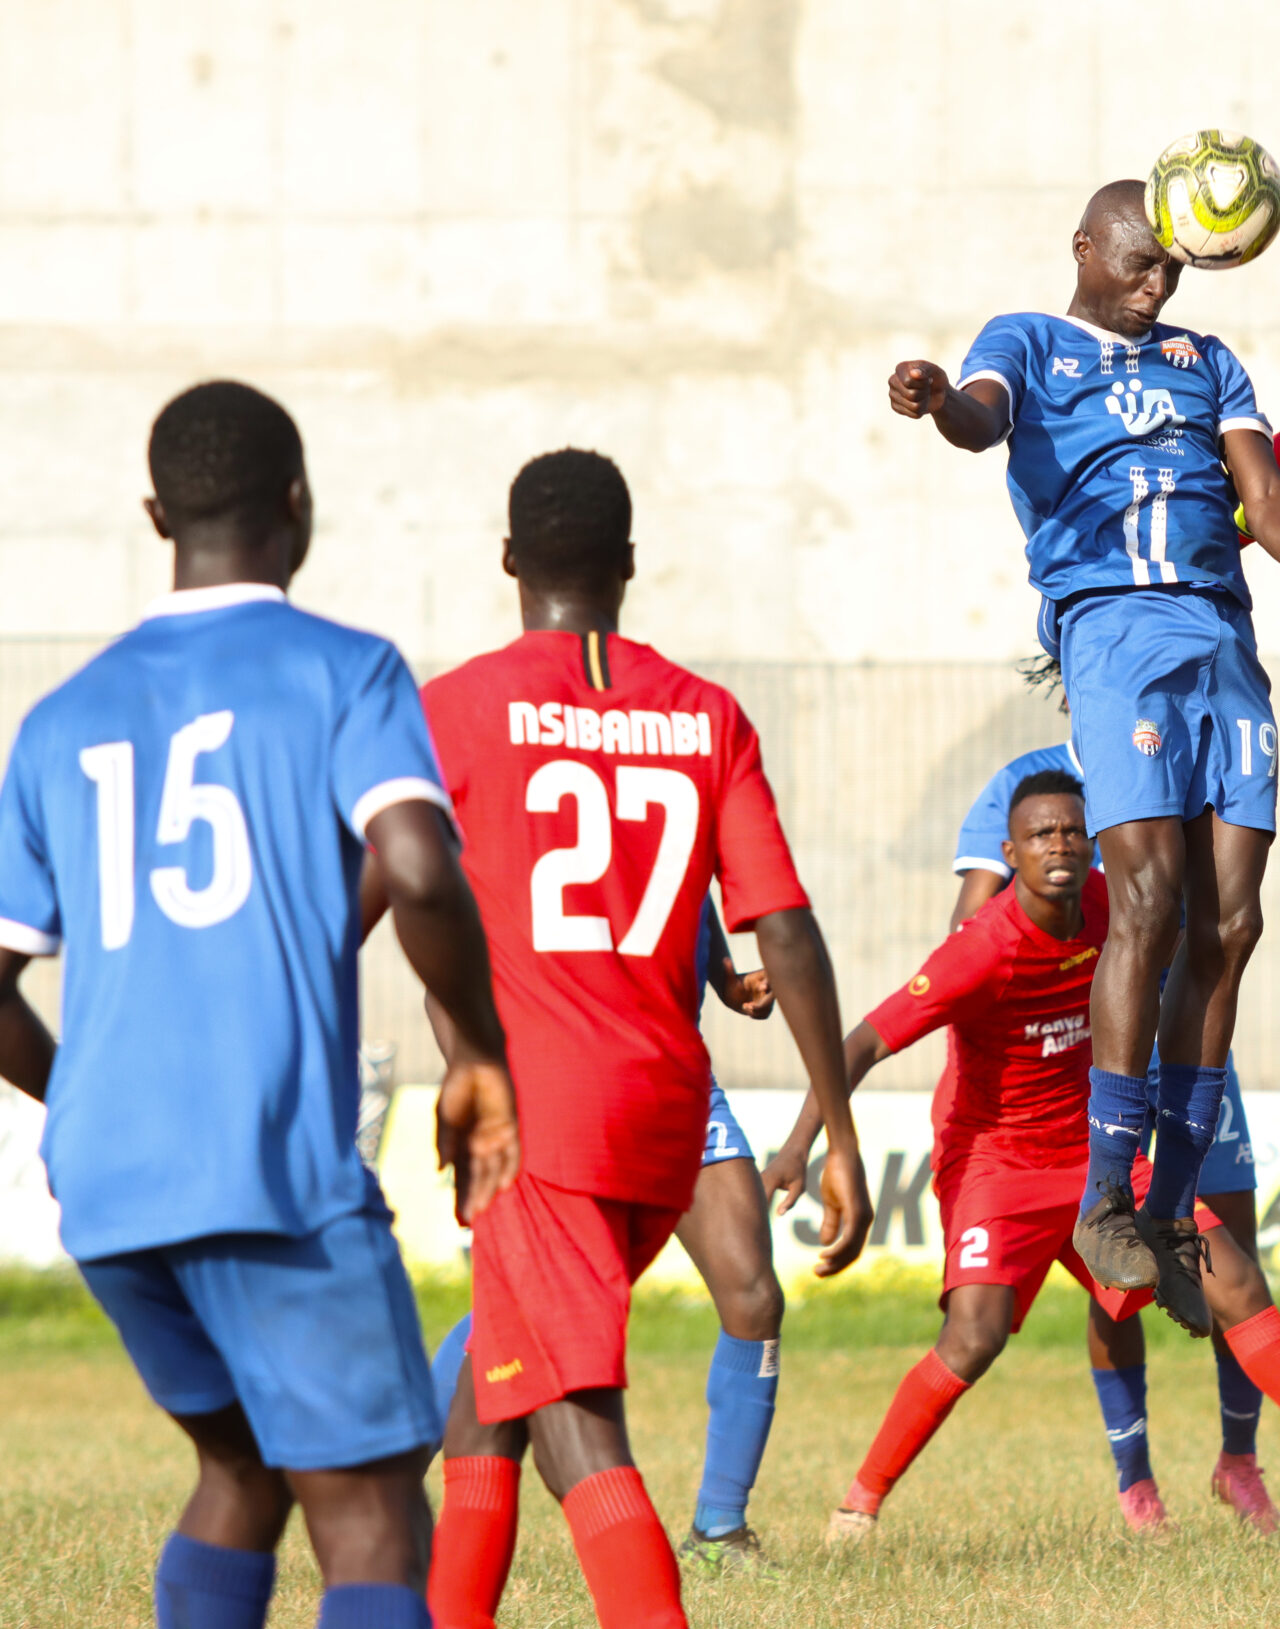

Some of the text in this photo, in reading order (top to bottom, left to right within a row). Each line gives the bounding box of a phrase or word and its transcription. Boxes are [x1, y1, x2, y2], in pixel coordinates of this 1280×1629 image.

[508, 702, 712, 756] NSIBAMBI
[1236, 719, 1278, 778] 19
[79, 710, 252, 951] 15
[525, 759, 700, 957] 27
[702, 1120, 739, 1160] 2
[1213, 1095, 1240, 1144] 2
[960, 1226, 989, 1268] 2
